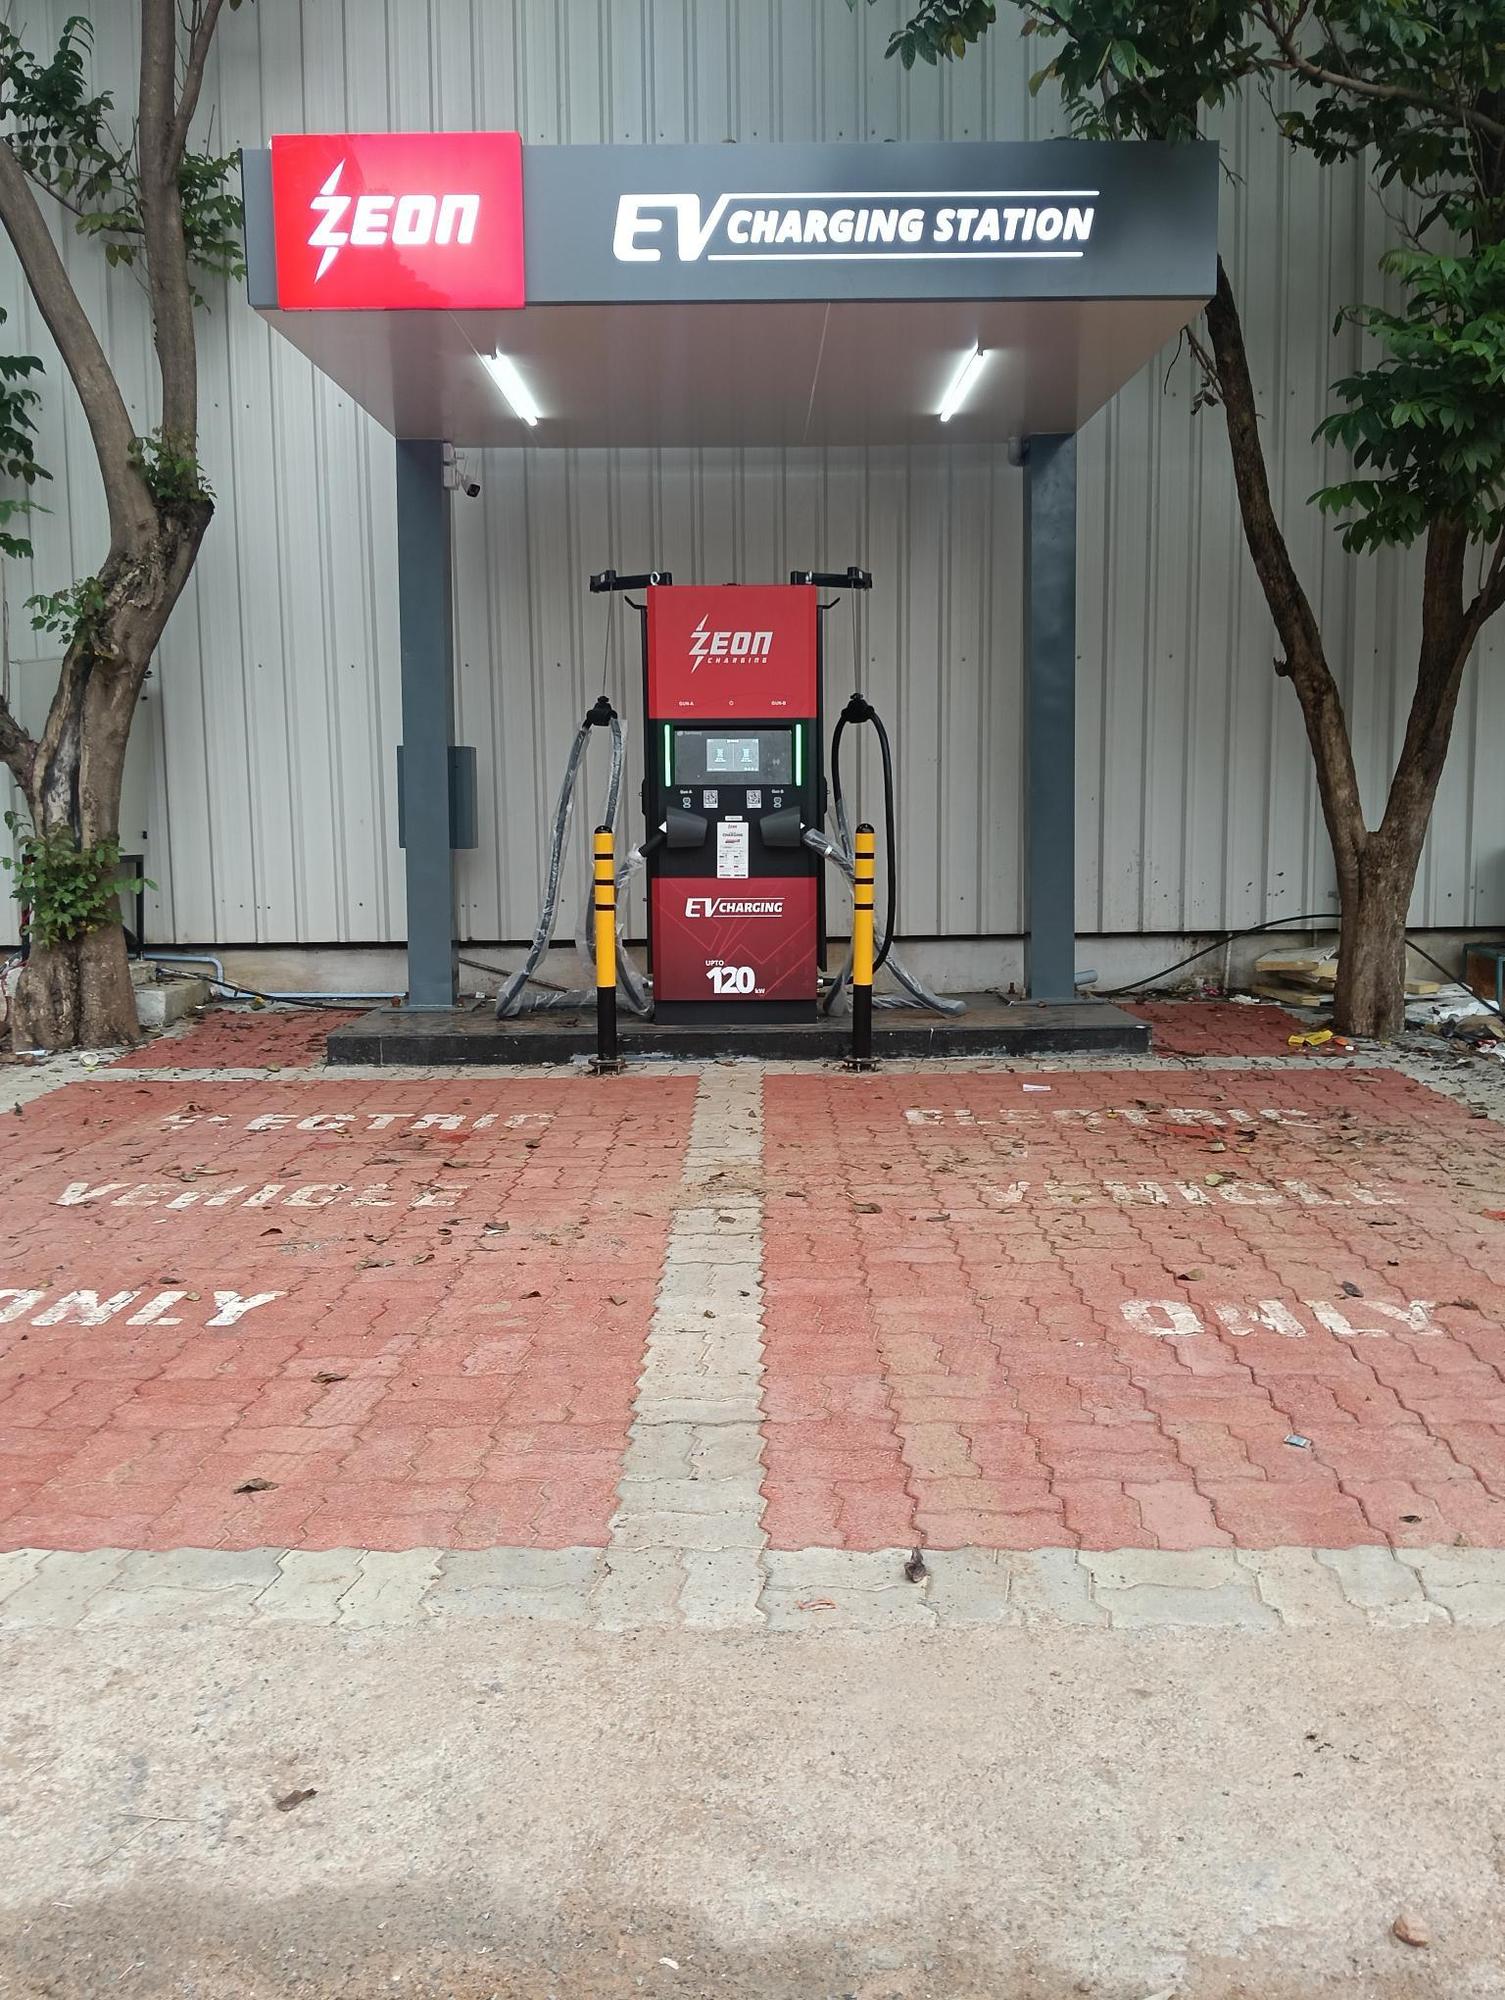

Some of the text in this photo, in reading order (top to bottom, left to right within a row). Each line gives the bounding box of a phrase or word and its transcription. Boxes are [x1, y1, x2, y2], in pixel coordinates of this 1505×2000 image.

[612, 192, 1096, 262] EV CHARGING STATION
[707, 656, 768, 664] CHARGING
[685, 897, 783, 918] EV CHARGING
[705, 959, 725, 967] UPTO
[705, 966, 756, 994] 120
[0, 1288, 287, 1327] ONLY
[1119, 1298, 1444, 1338] ONLY
